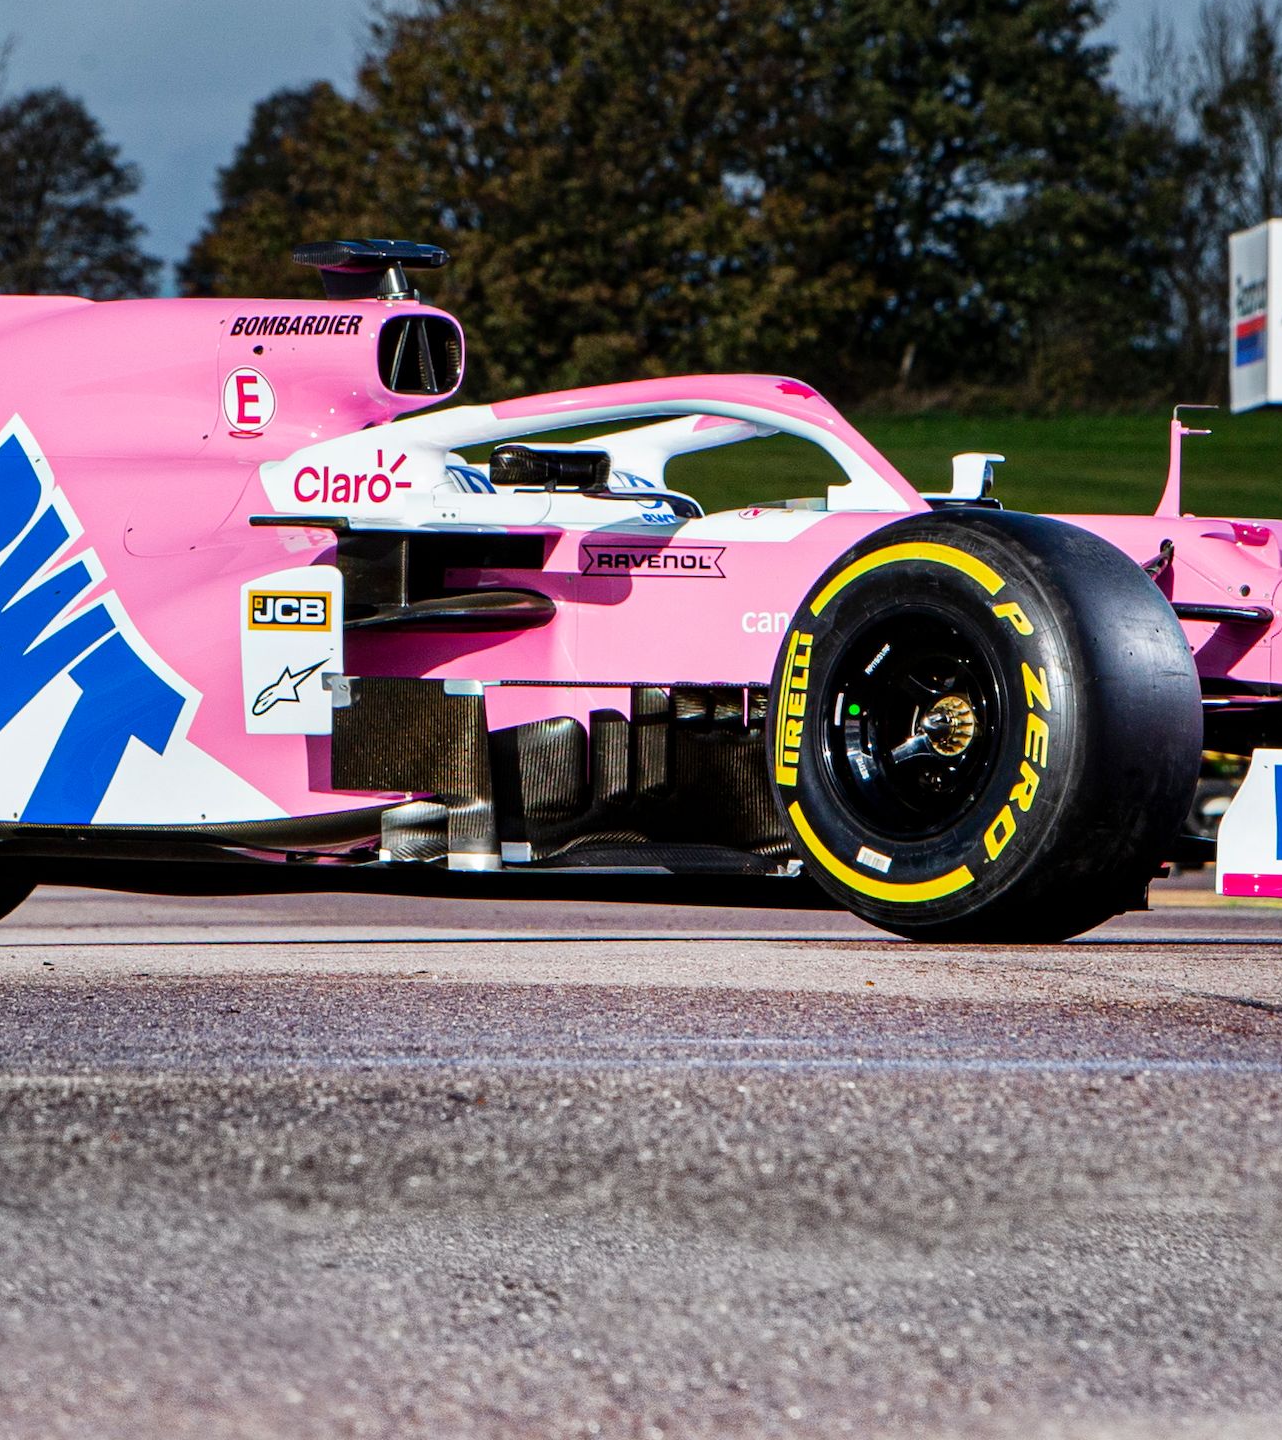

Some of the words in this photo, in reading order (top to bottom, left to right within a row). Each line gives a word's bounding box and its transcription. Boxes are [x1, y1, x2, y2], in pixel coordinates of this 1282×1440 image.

[230, 315, 363, 336] BOMBARDIER
[235, 375, 261, 424] E
[294, 466, 391, 503] Claro
[597, 553, 711, 569] RAVENOL
[254, 597, 325, 624] JCB
[992, 602, 1035, 636] P
[775, 629, 814, 787] PIRELLI
[983, 662, 1052, 861] ZERO
